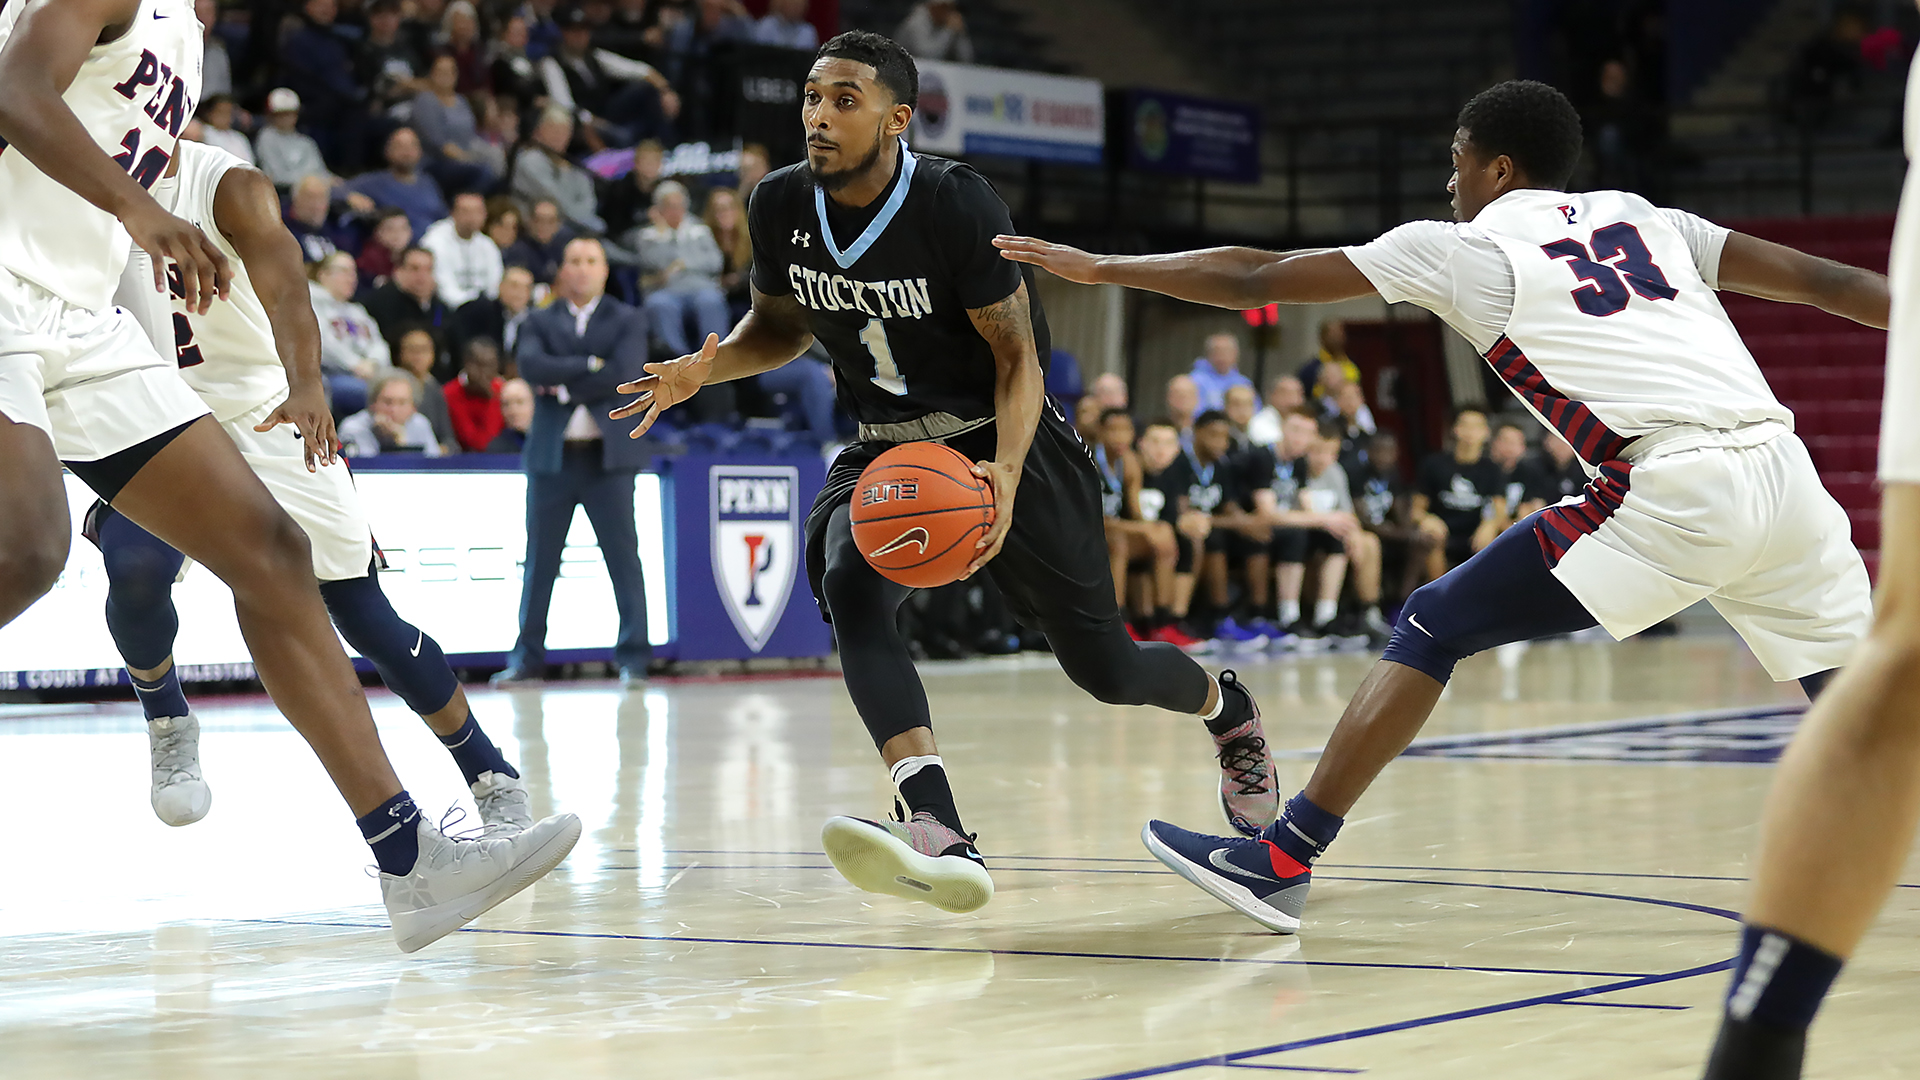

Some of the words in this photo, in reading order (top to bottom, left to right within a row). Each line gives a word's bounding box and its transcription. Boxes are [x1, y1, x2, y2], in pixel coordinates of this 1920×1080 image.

[788, 263, 933, 319] STOCKTON
[1540, 221, 1679, 317] 33
[858, 317, 908, 396] 1
[719, 478, 789, 514] PENN
[861, 483, 918, 508] ELITE
[25, 669, 88, 690] COURT
[94, 667, 121, 687] AT
